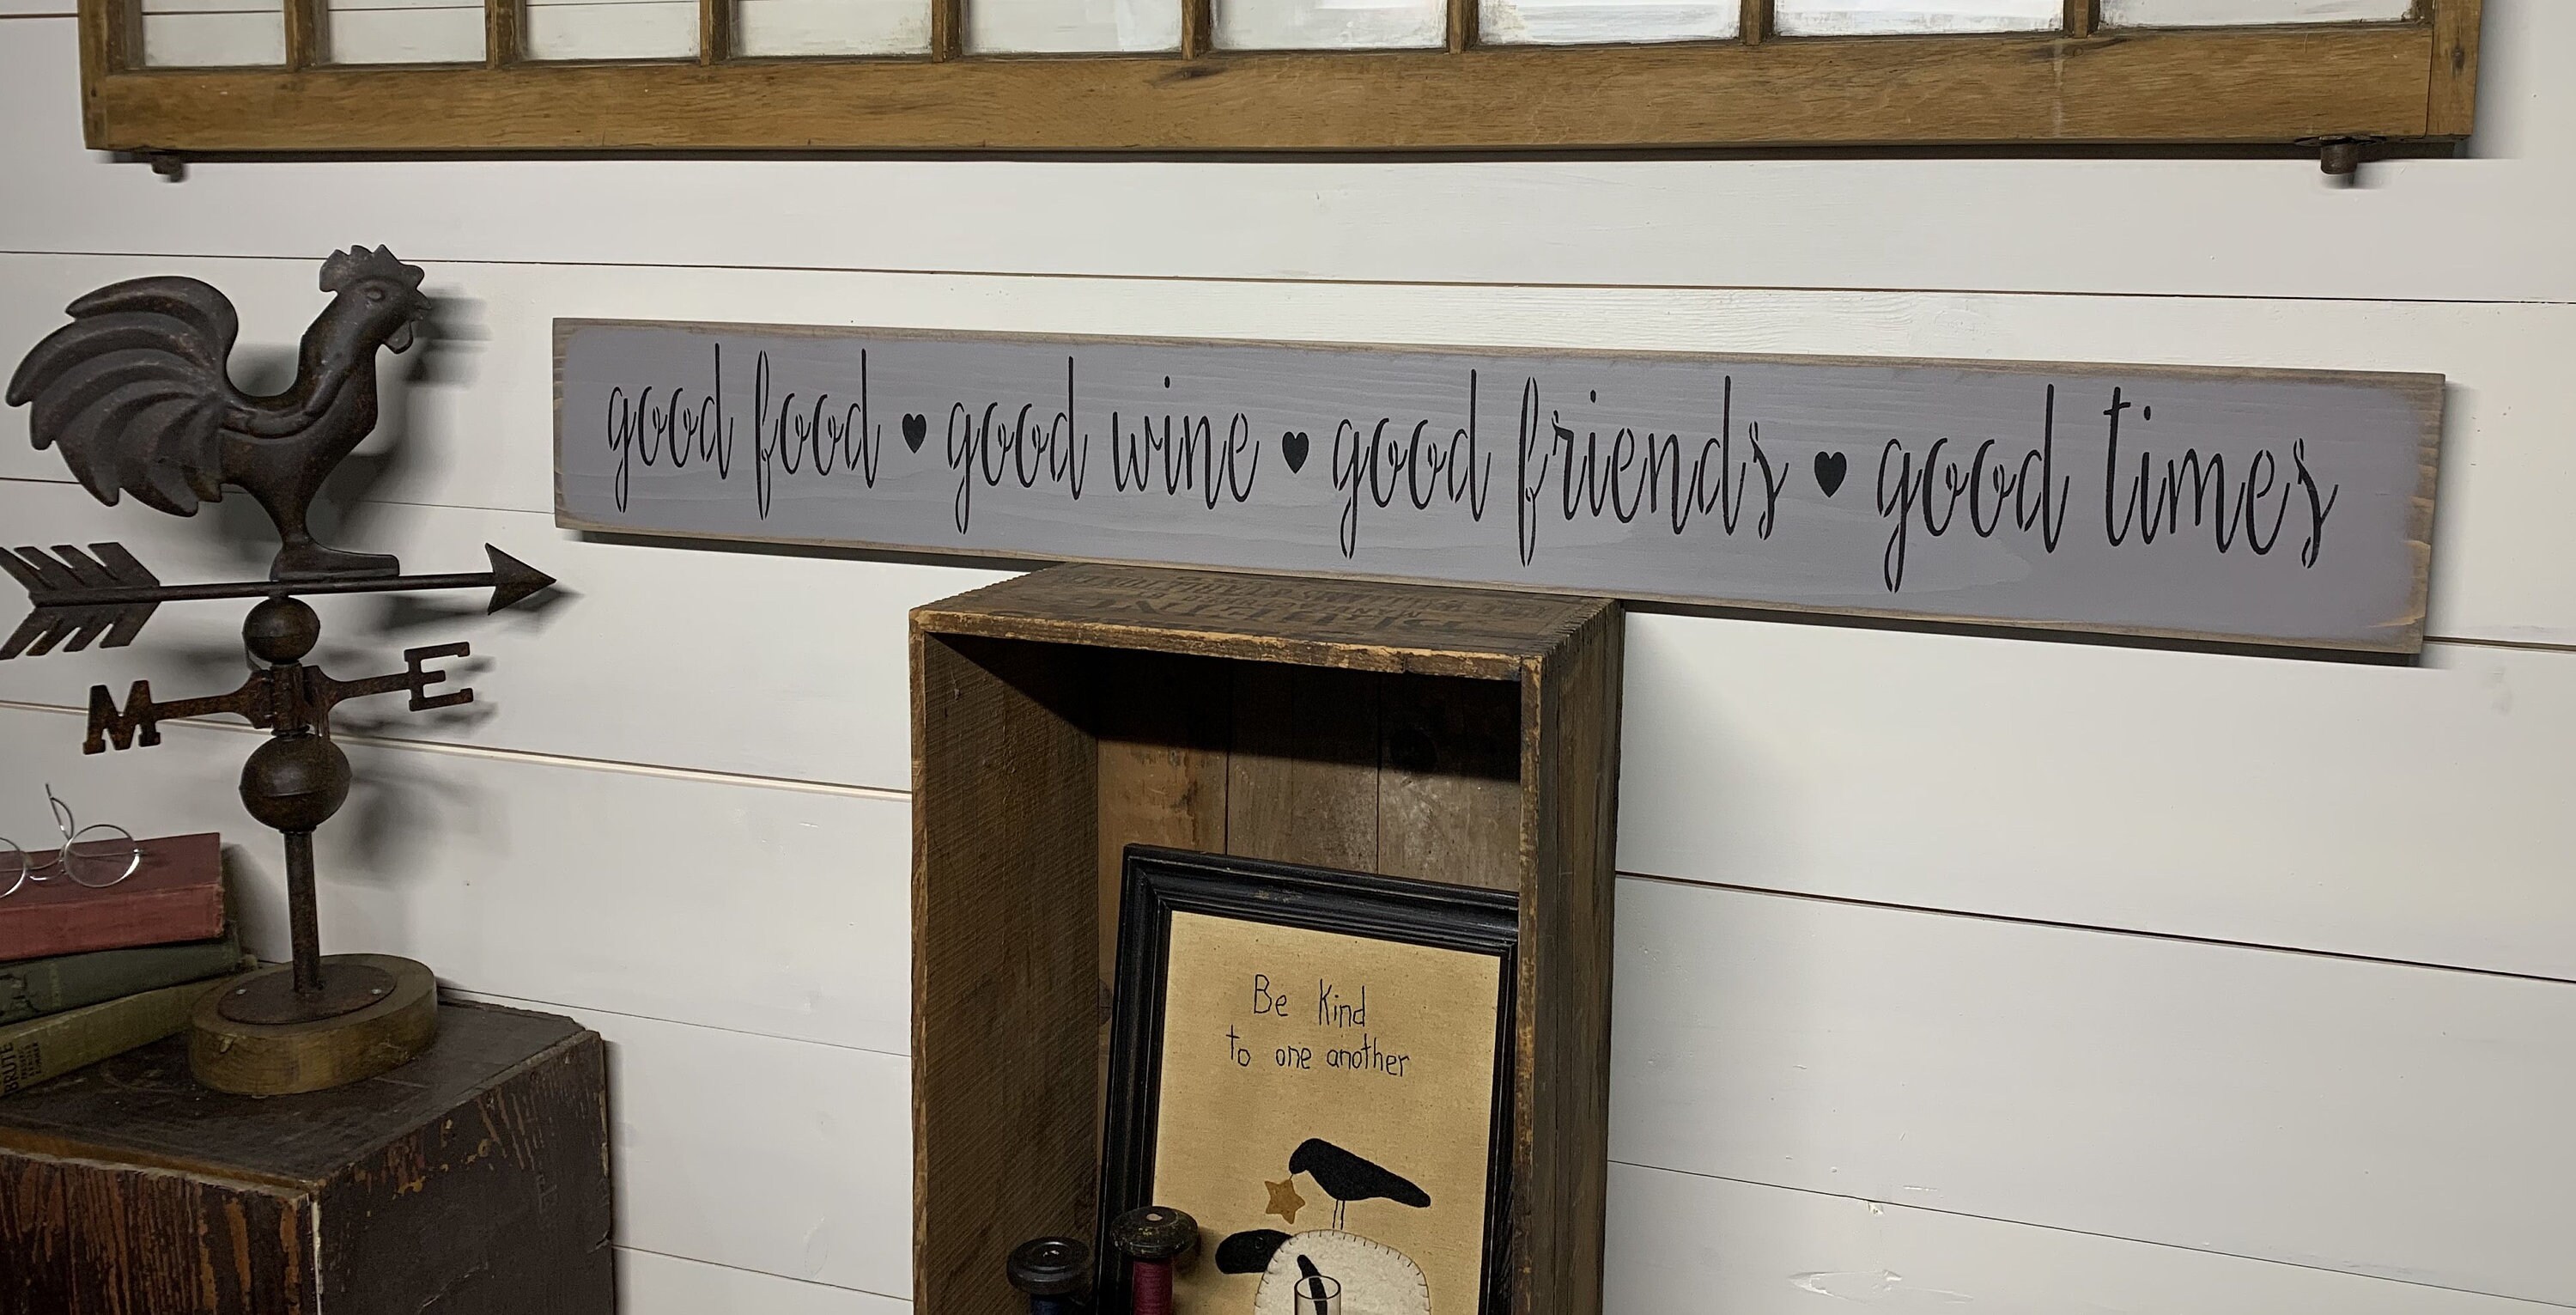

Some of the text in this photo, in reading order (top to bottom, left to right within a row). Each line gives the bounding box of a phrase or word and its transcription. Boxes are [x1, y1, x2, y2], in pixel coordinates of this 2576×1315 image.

[607, 343, 2339, 594] good food good wine good friends good times
[404, 641, 474, 711] E
[1254, 974, 1366, 1028] Be Kind
[0, 1042, 18, 1093] BRUTE
[1226, 1024, 1410, 1077] to one another
